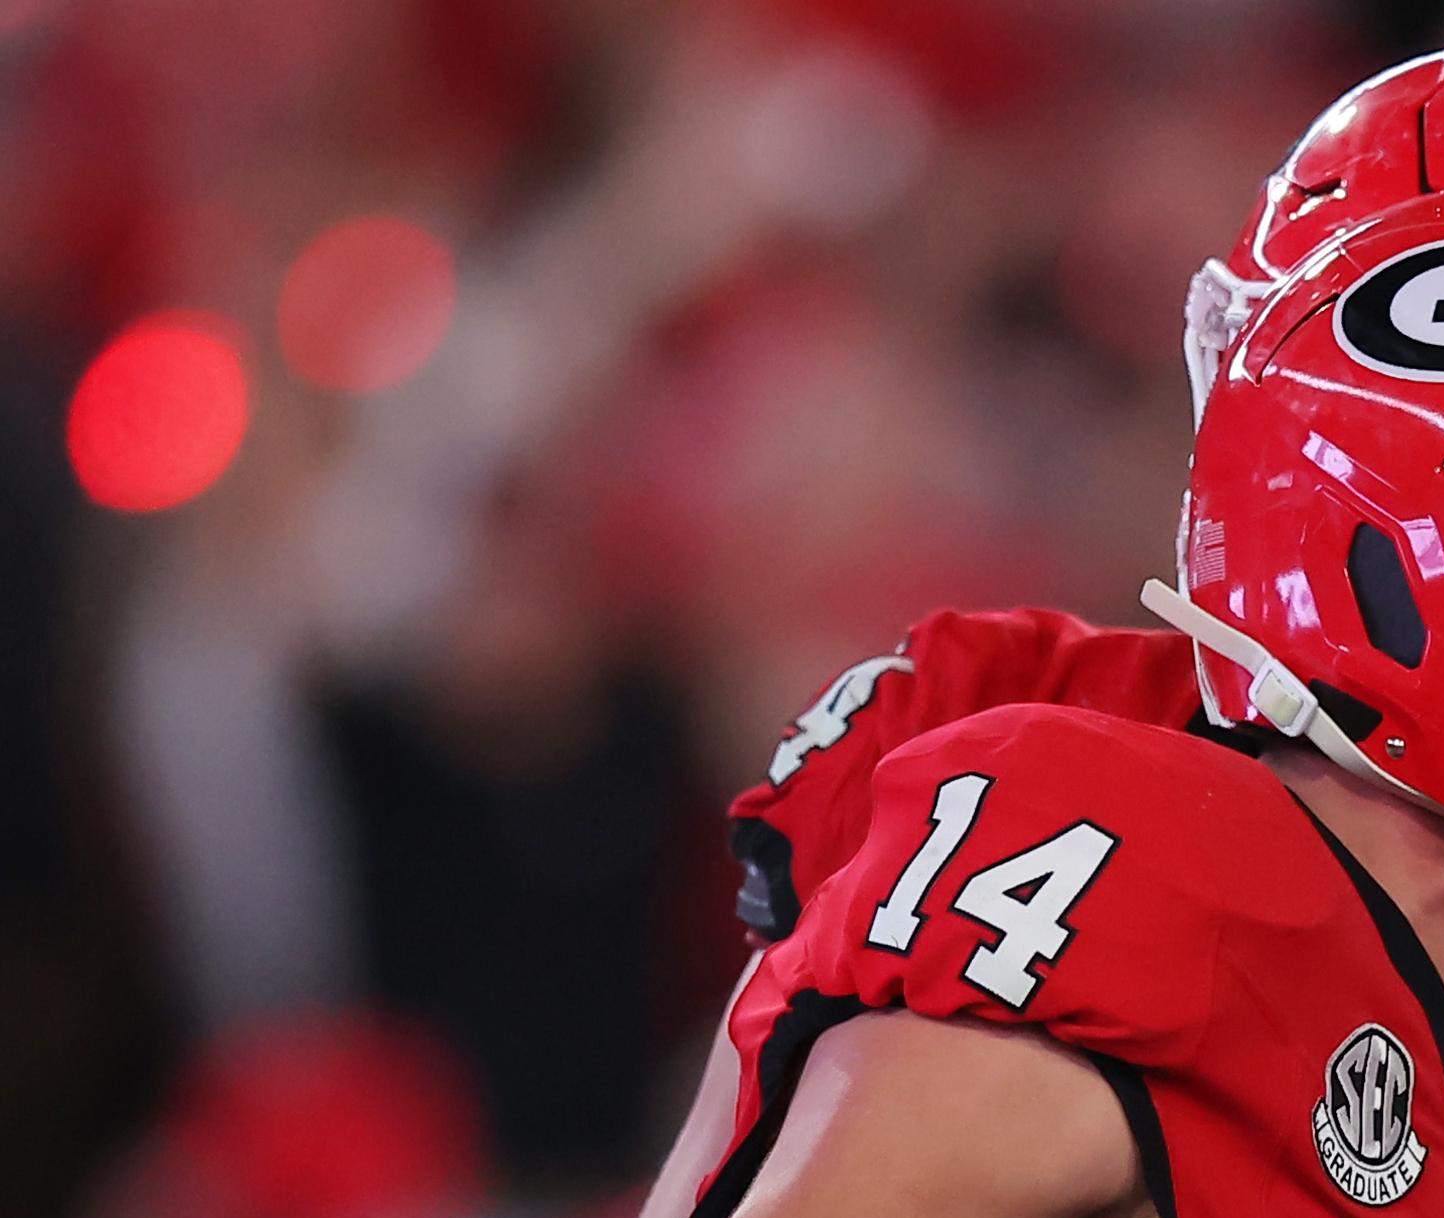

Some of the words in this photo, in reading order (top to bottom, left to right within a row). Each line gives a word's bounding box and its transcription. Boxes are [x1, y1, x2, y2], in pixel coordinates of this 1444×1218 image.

[865, 771, 1122, 1012] 14
[1335, 1034, 1407, 1161] SEC
[1322, 1137, 1414, 1202] GRADUATE
